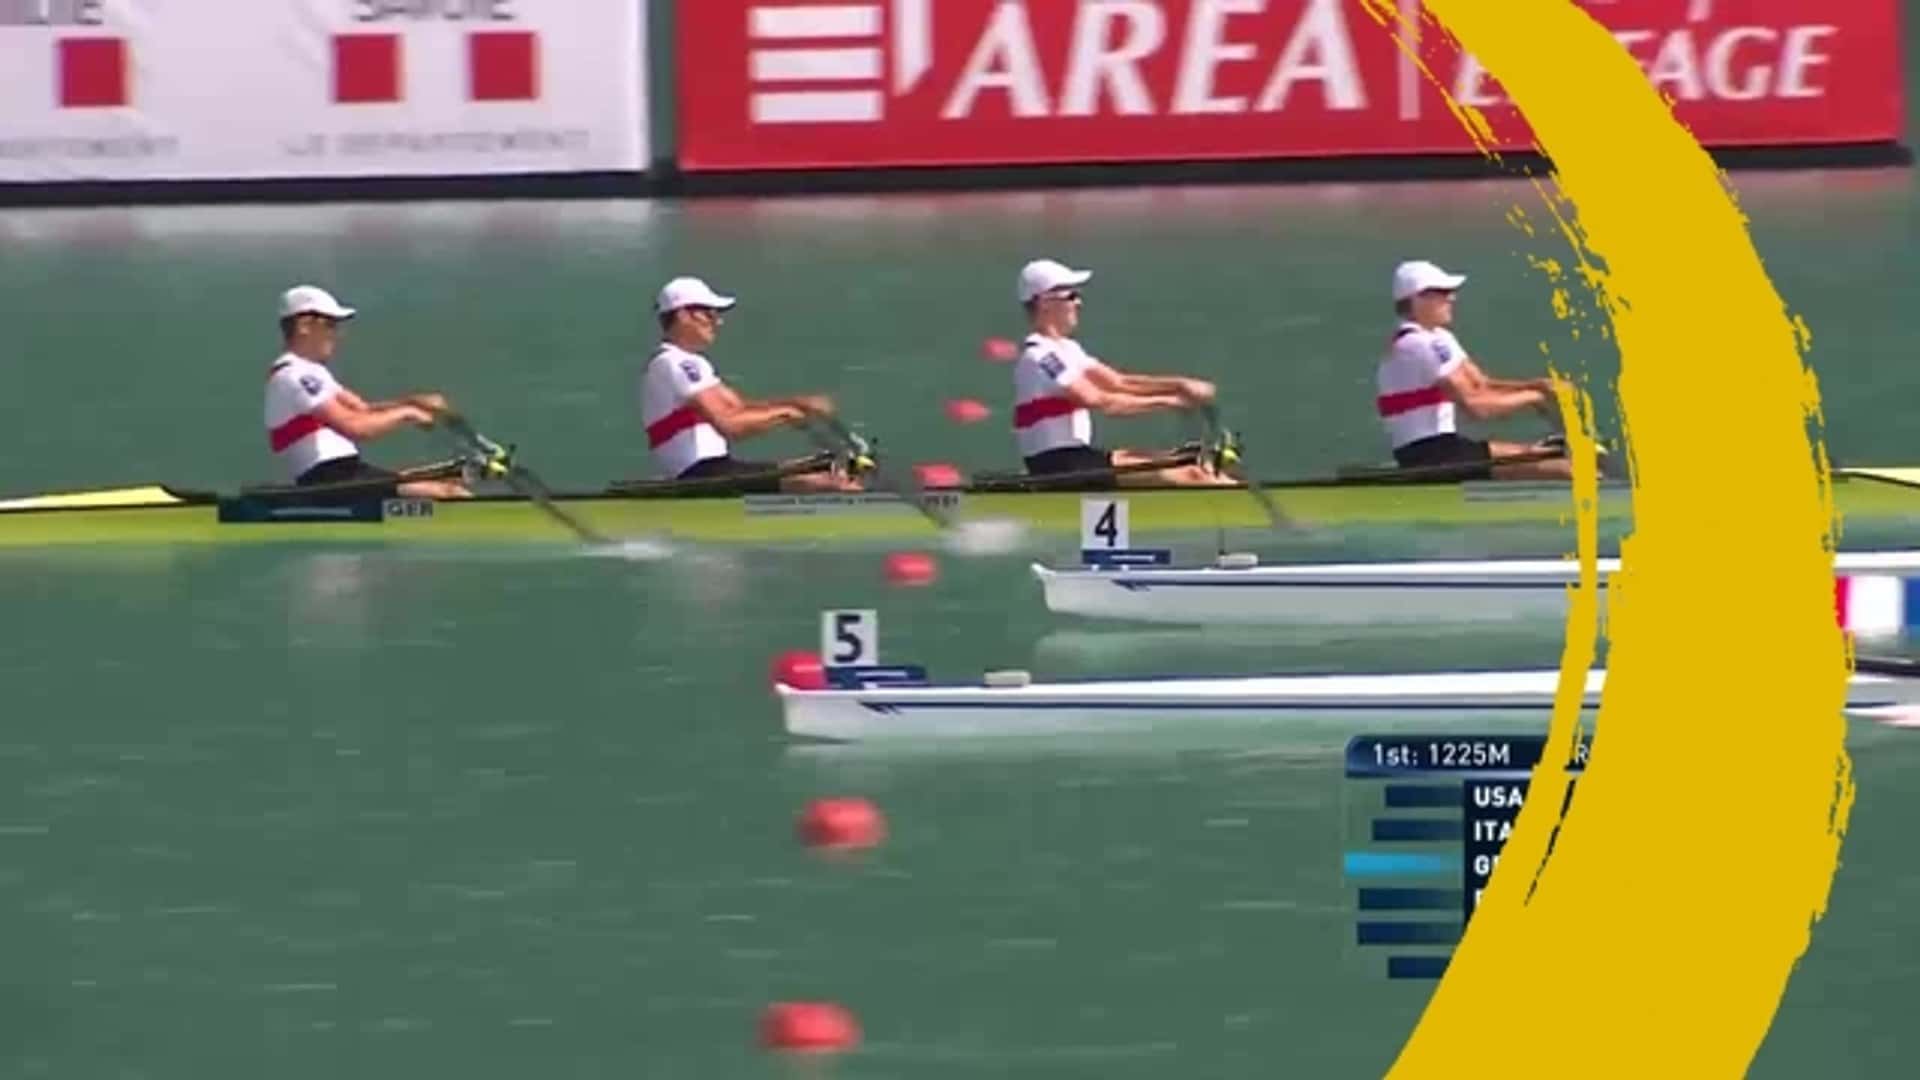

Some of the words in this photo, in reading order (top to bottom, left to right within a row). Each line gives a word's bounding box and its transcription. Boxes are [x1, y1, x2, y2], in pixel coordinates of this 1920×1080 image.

[940, 0, 1368, 119] AREA
[1094, 501, 1118, 547] 4
[833, 613, 863, 663] 5
